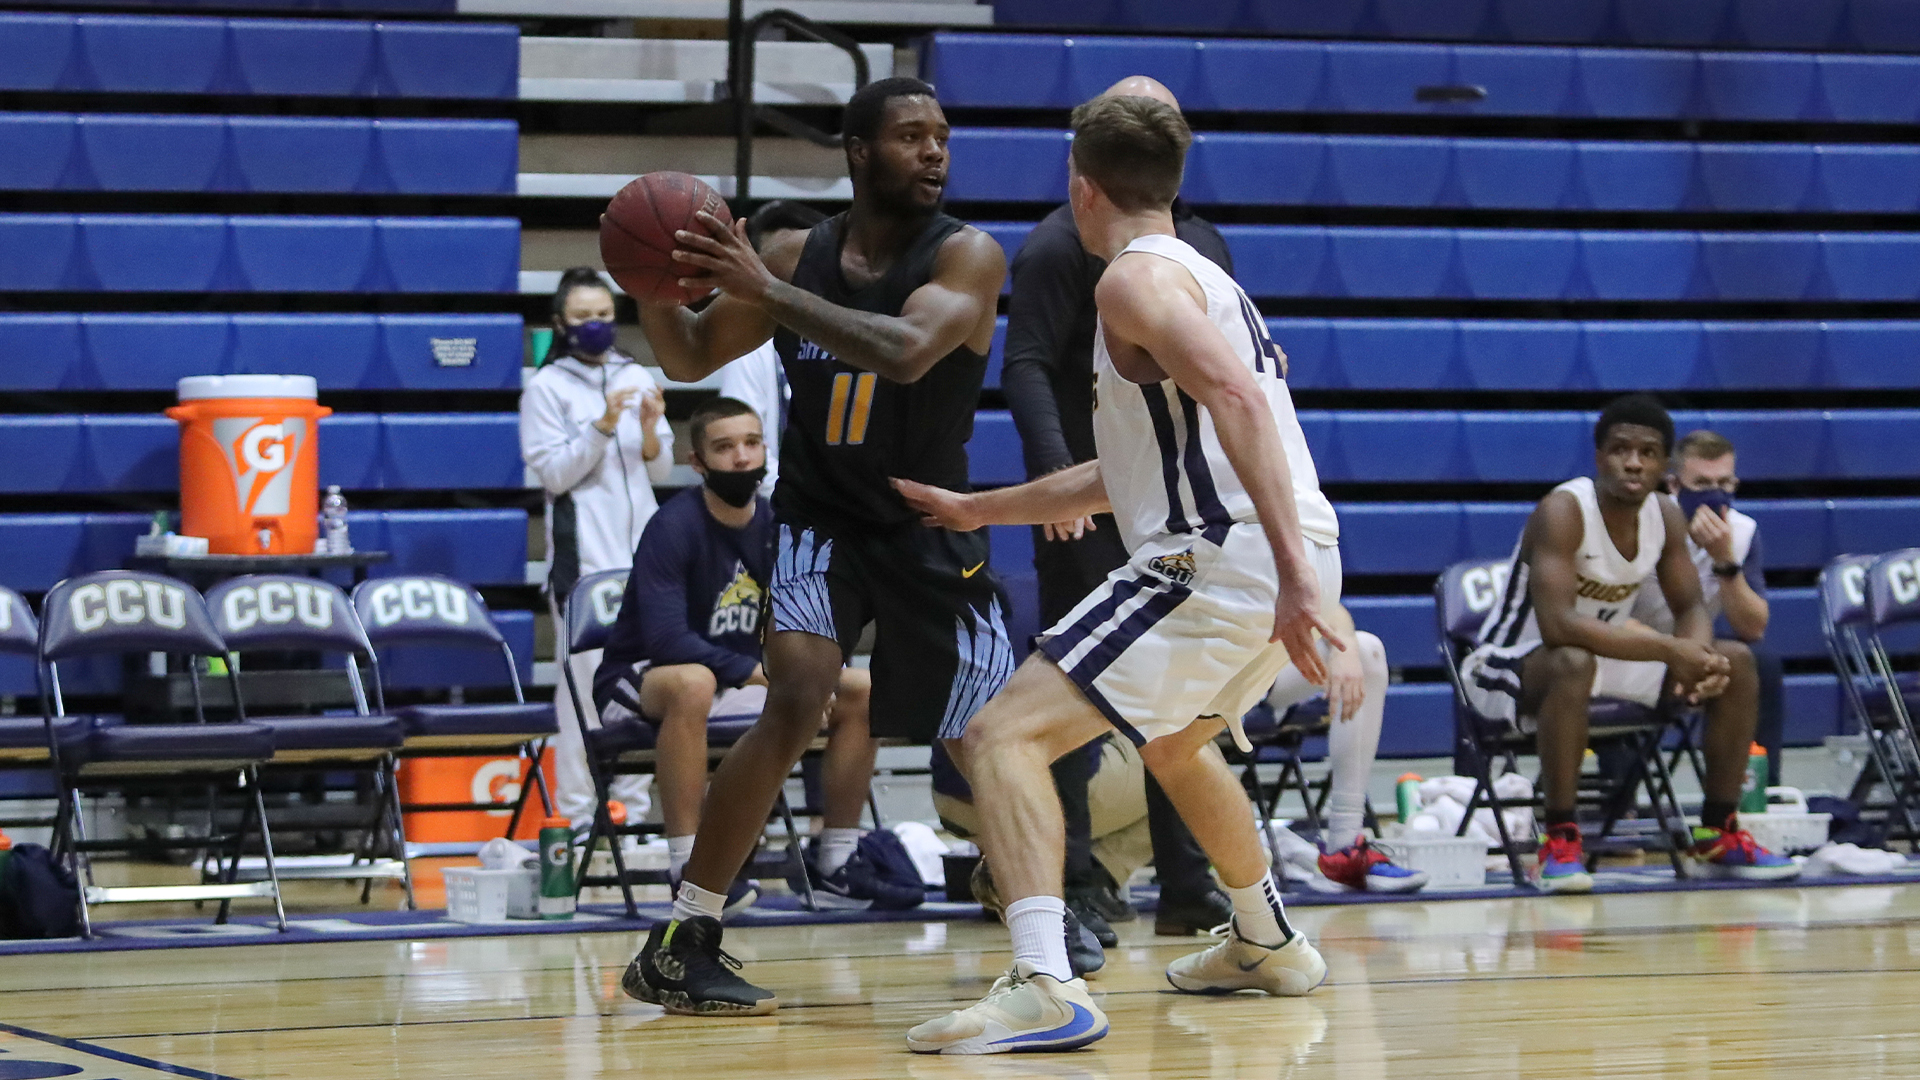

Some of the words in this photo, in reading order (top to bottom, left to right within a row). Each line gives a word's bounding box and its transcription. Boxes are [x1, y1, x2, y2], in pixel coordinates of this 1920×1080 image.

[825, 371, 878, 446] 11
[243, 423, 285, 472] G
[1148, 557, 1194, 586] CCU
[70, 579, 186, 632] CCU
[223, 582, 333, 631] CCU
[371, 579, 468, 626] CCU
[708, 604, 759, 637] CCU
[472, 758, 522, 817] G
[549, 842, 568, 866] G
